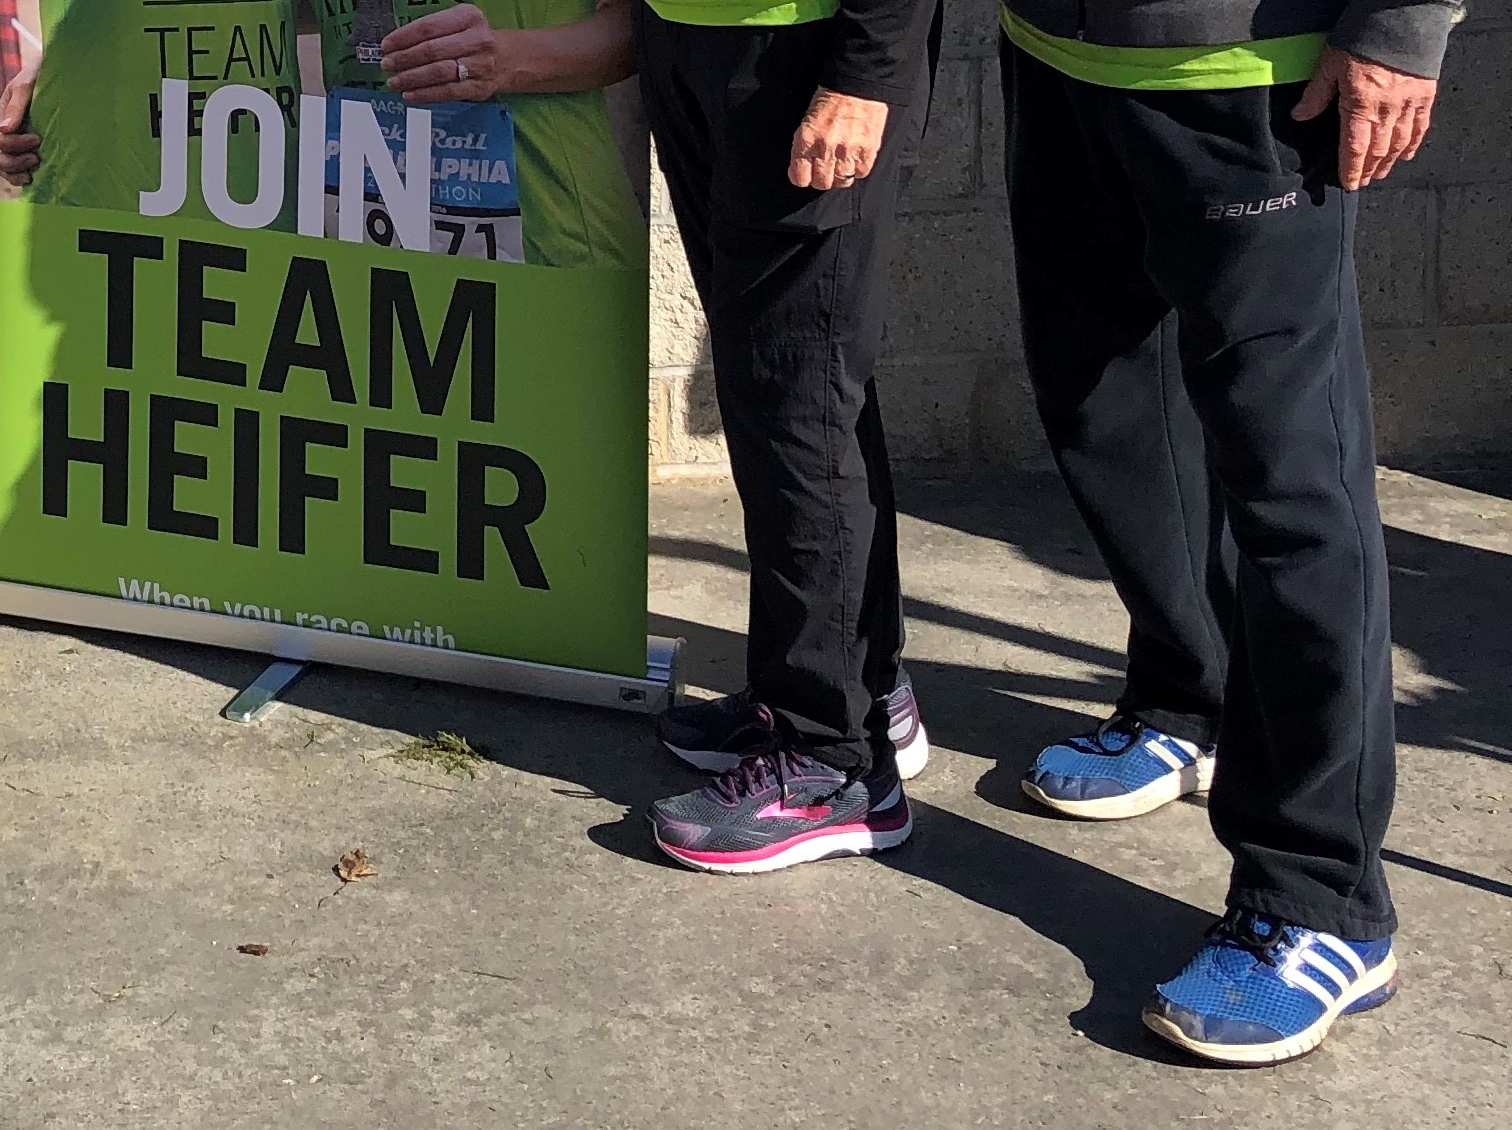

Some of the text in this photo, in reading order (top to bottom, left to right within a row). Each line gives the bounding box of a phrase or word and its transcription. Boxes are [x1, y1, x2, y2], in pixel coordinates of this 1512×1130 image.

[144, 21, 286, 81] TEAM
[139, 78, 432, 251] JOIN
[1204, 191, 1297, 220] BAUER
[78, 228, 497, 424] TEAM
[42, 381, 550, 591] HEIFER
[118, 576, 211, 612] When
[383, 620, 456, 650] with
